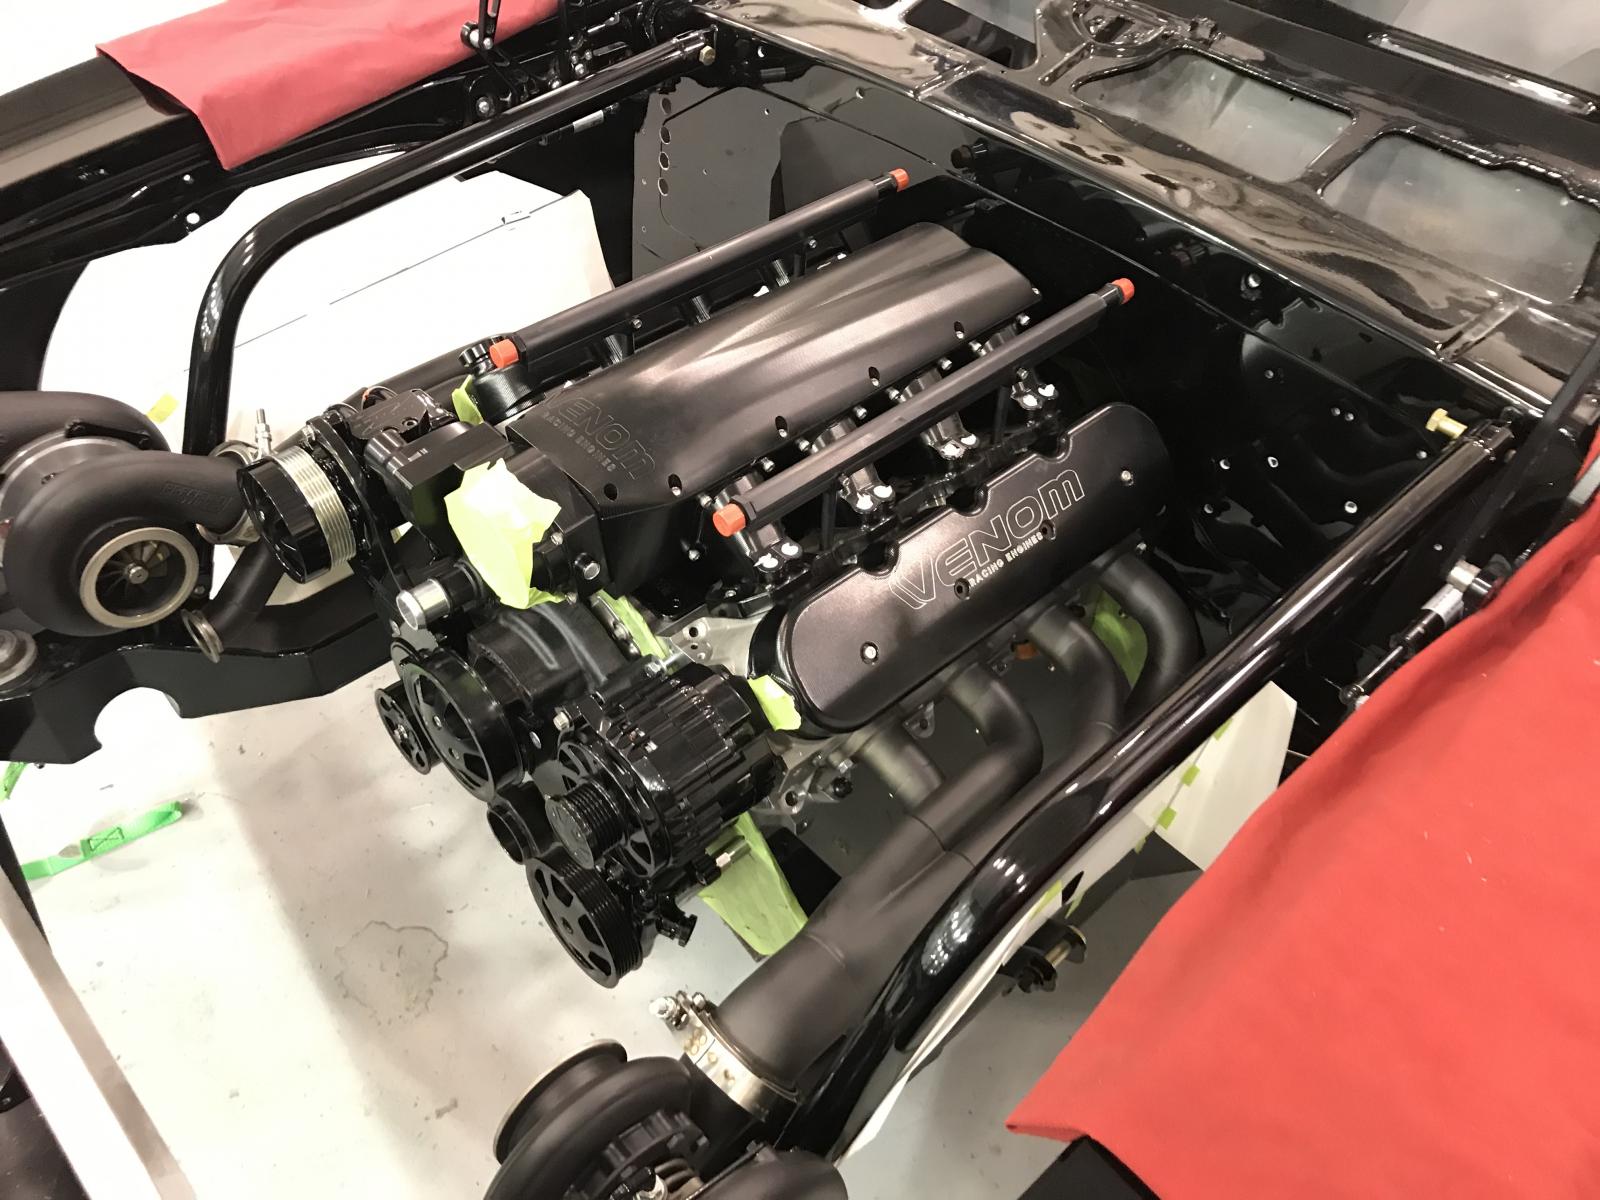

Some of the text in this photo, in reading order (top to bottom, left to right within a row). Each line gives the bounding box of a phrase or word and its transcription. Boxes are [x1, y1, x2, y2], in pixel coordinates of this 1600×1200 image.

[889, 469, 1085, 609] VENOM
[968, 531, 1044, 588] RACING ENGINES
